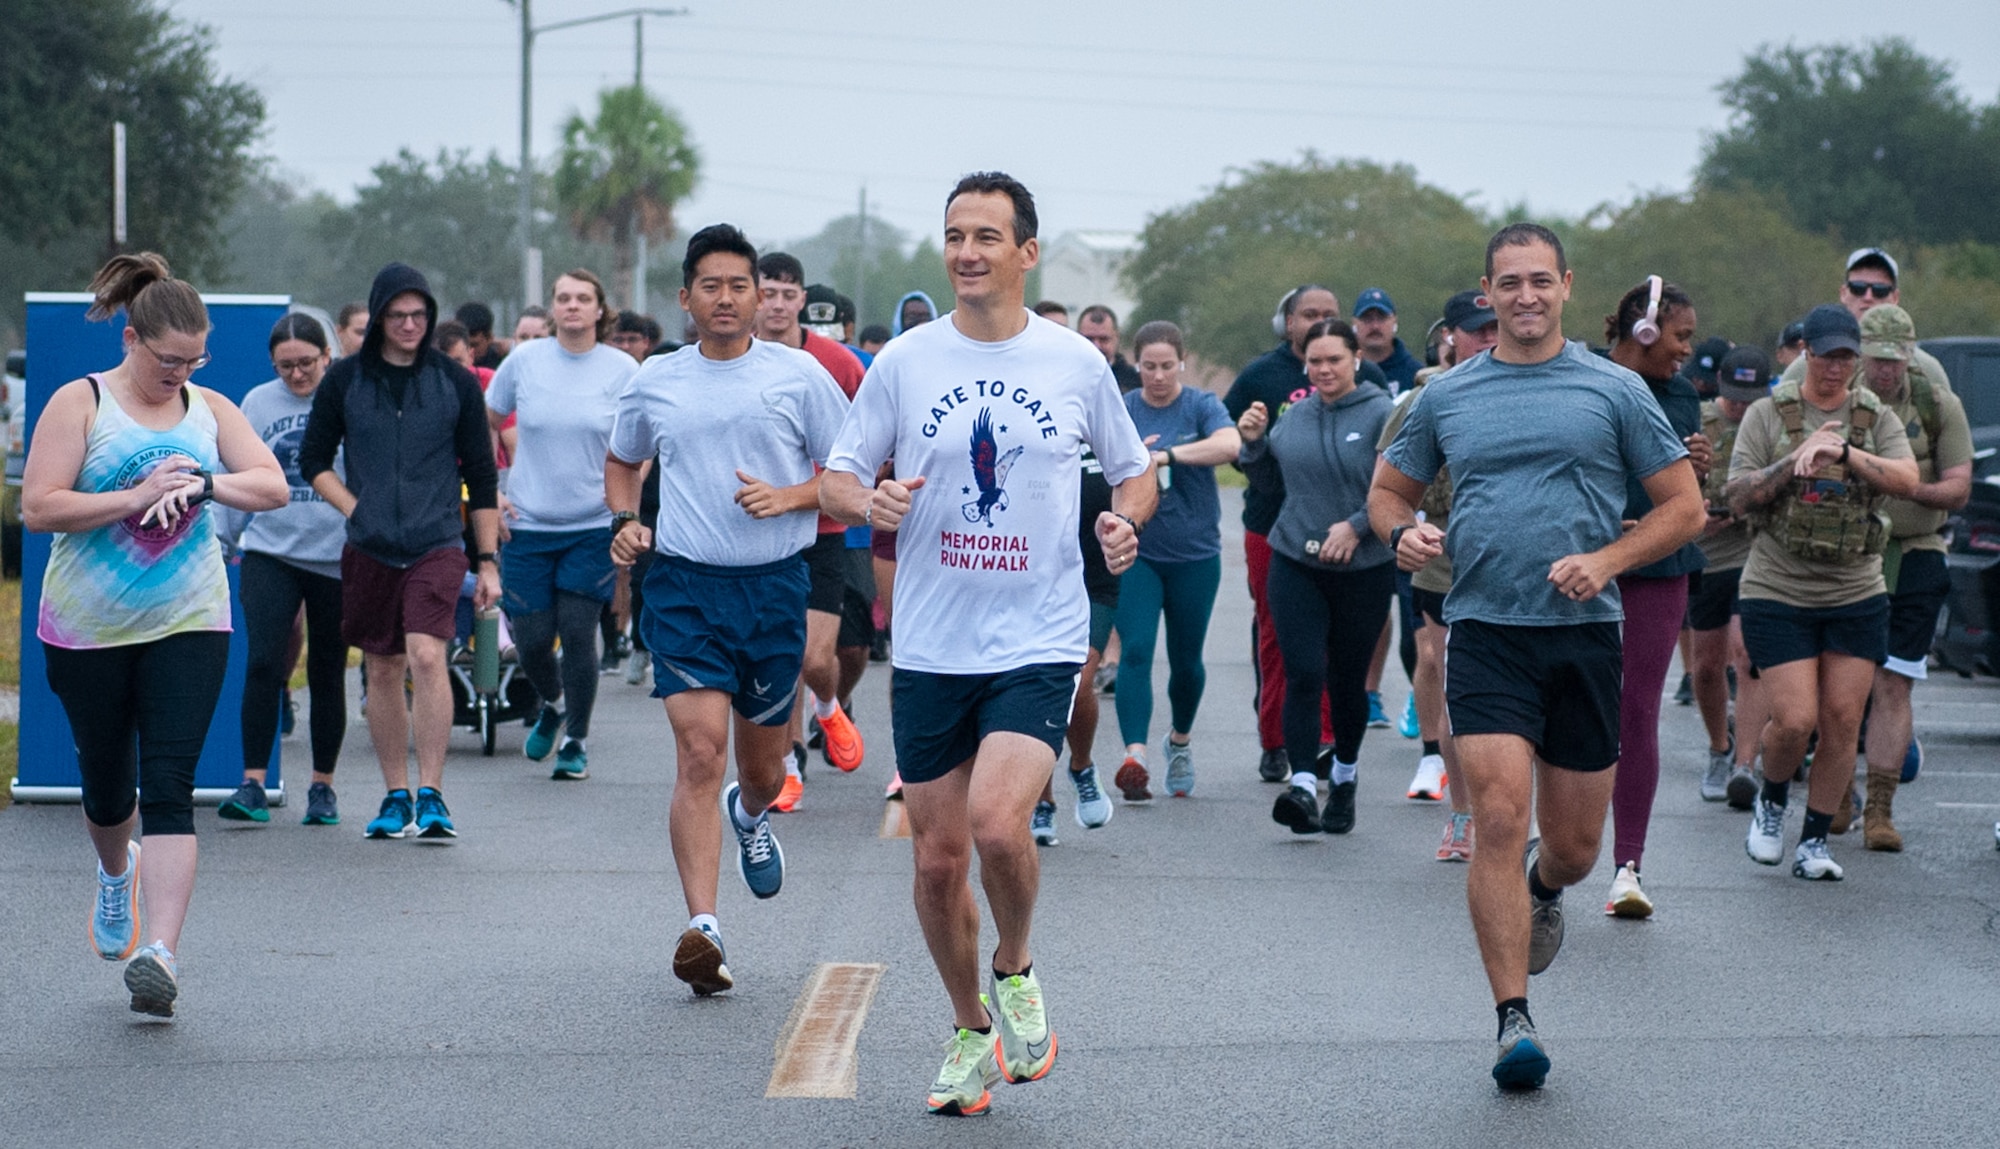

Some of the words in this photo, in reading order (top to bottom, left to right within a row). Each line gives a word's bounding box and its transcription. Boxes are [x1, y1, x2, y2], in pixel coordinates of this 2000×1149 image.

[922, 386, 969, 438] GATE
[975, 380, 1005, 397] TO
[1012, 388, 1058, 439] GATE
[139, 452, 156, 464] AIR
[941, 530, 1029, 552] MEMORIAL
[941, 550, 1029, 571] RUN/WALK
